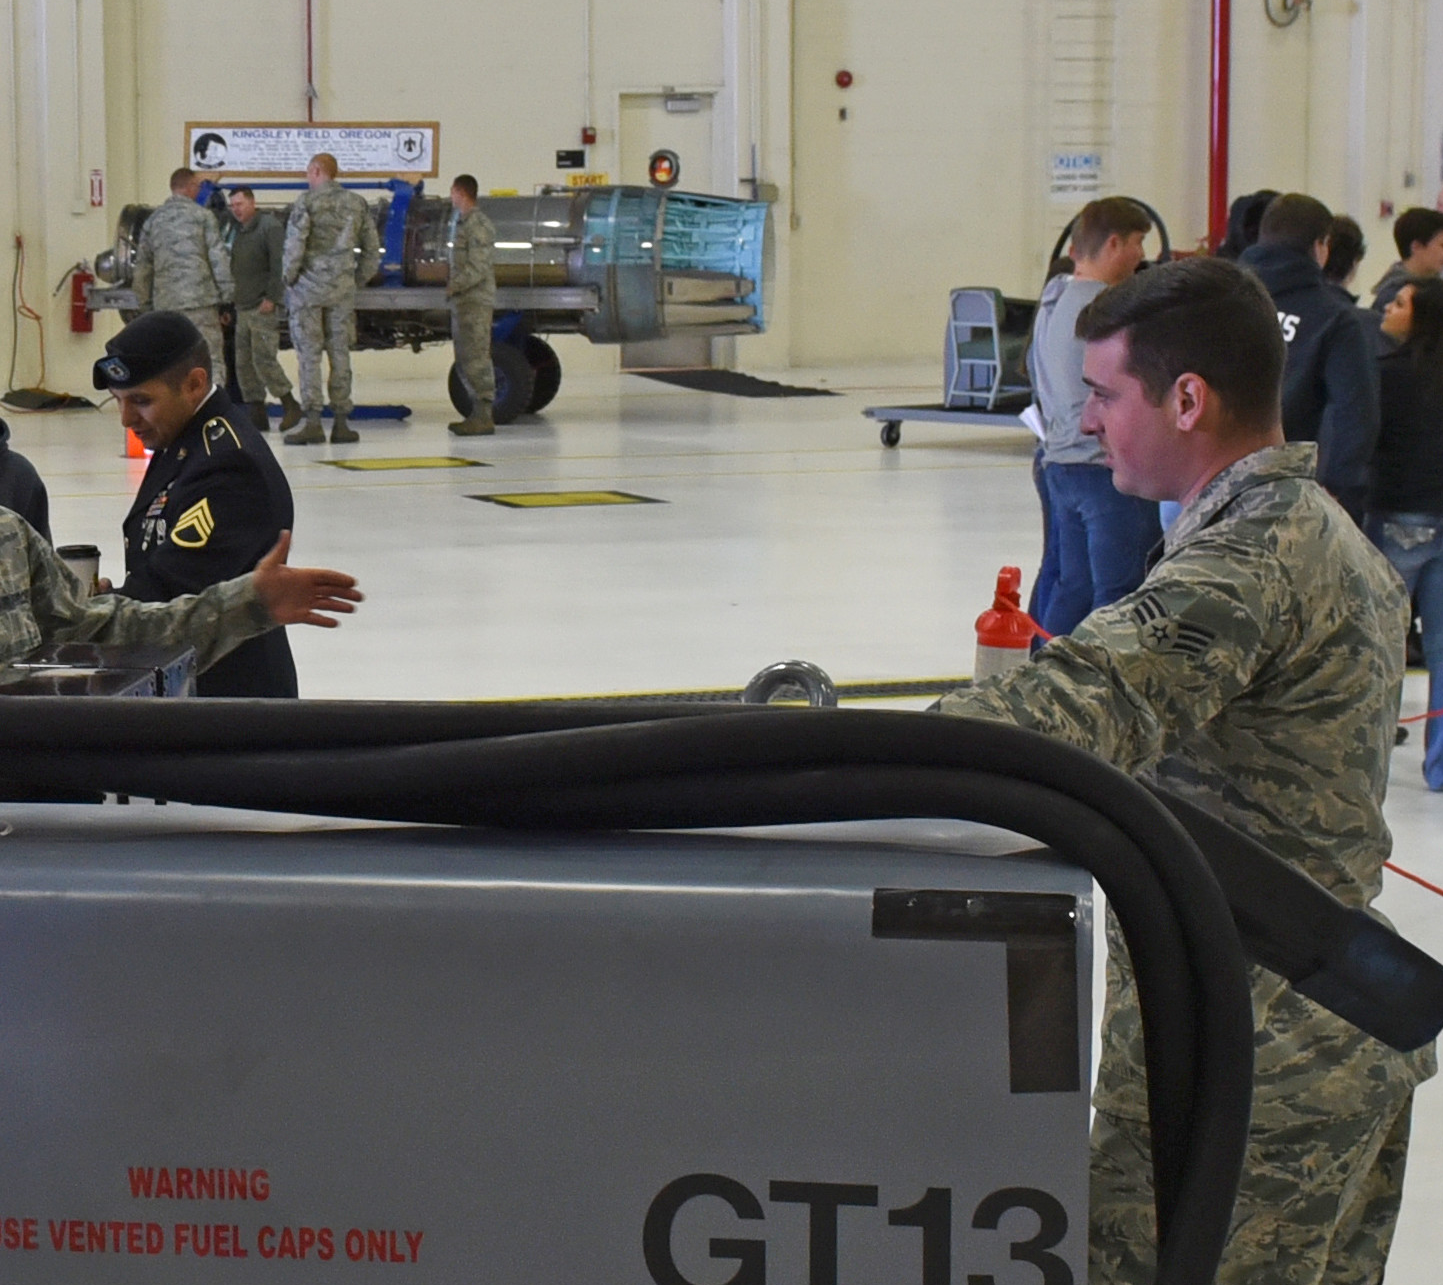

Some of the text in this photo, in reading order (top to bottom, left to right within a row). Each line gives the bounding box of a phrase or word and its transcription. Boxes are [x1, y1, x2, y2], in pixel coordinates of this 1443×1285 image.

[232, 129, 292, 140] KINGSLEY
[338, 129, 392, 140] OREGON
[571, 173, 604, 186] START
[127, 1166, 270, 1202] WARNING
[48, 1219, 164, 1255] VENTED
[174, 1223, 248, 1258] FUEL
[257, 1225, 336, 1261] CAPS
[345, 1227, 424, 1263] ONLY
